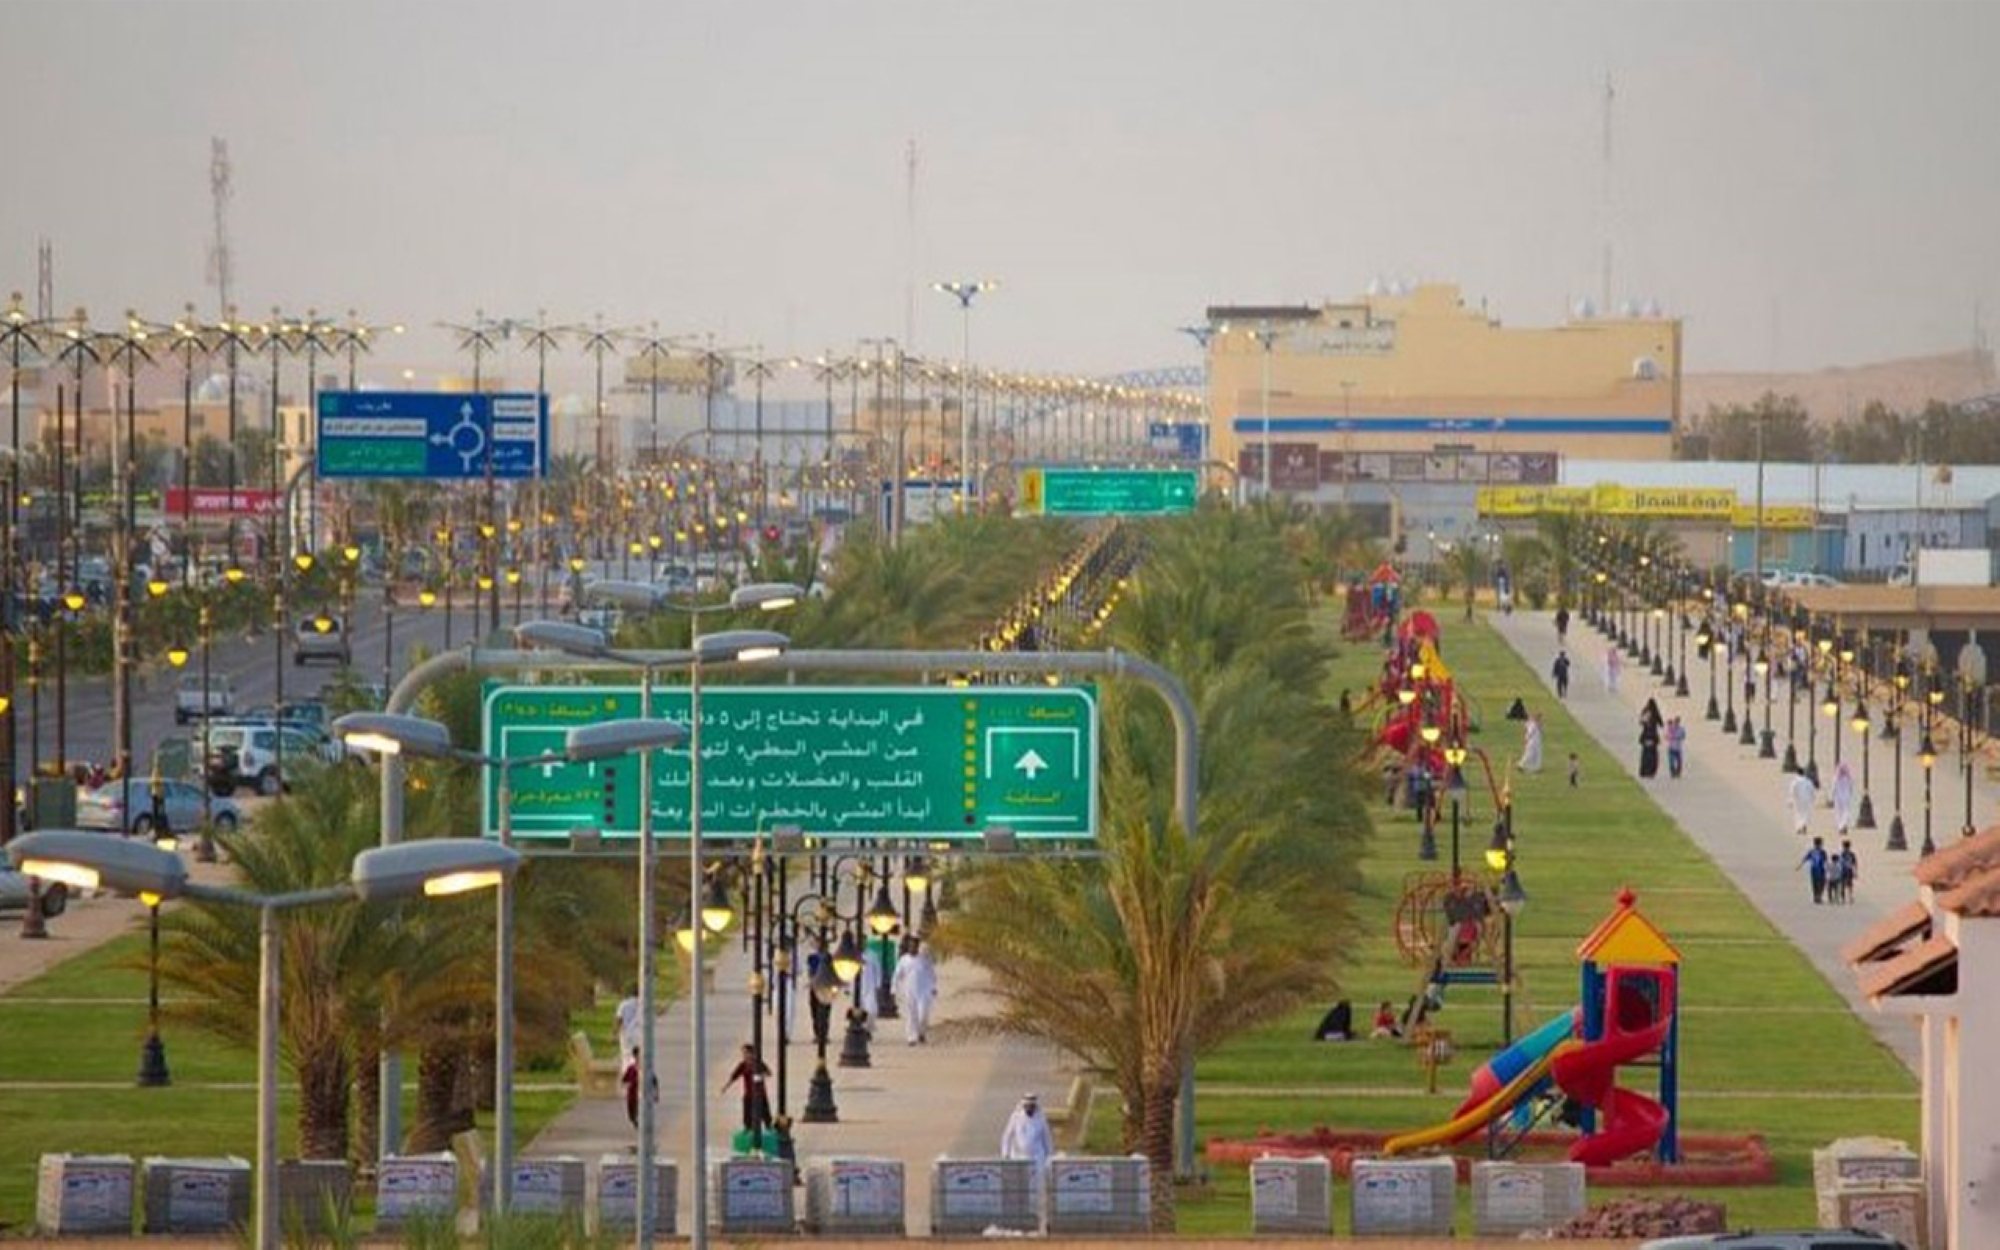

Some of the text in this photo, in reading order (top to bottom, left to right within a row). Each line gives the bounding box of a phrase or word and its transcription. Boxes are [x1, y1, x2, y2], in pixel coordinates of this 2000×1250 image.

[733, 709, 760, 731] إلى
[766, 709, 819, 731] تحتاج
[828, 708, 888, 729] البداية
[894, 707, 923, 734] في
[737, 739, 806, 767] البطيء
[813, 740, 877, 765] المشي
[884, 743, 918, 760] من
[658, 770, 922, 791] القلب والعضلات وبعد لك
[652, 801, 725, 821] السيعة
[729, 800, 826, 821] بالخطوات
[833, 802, 891, 828] المشي
